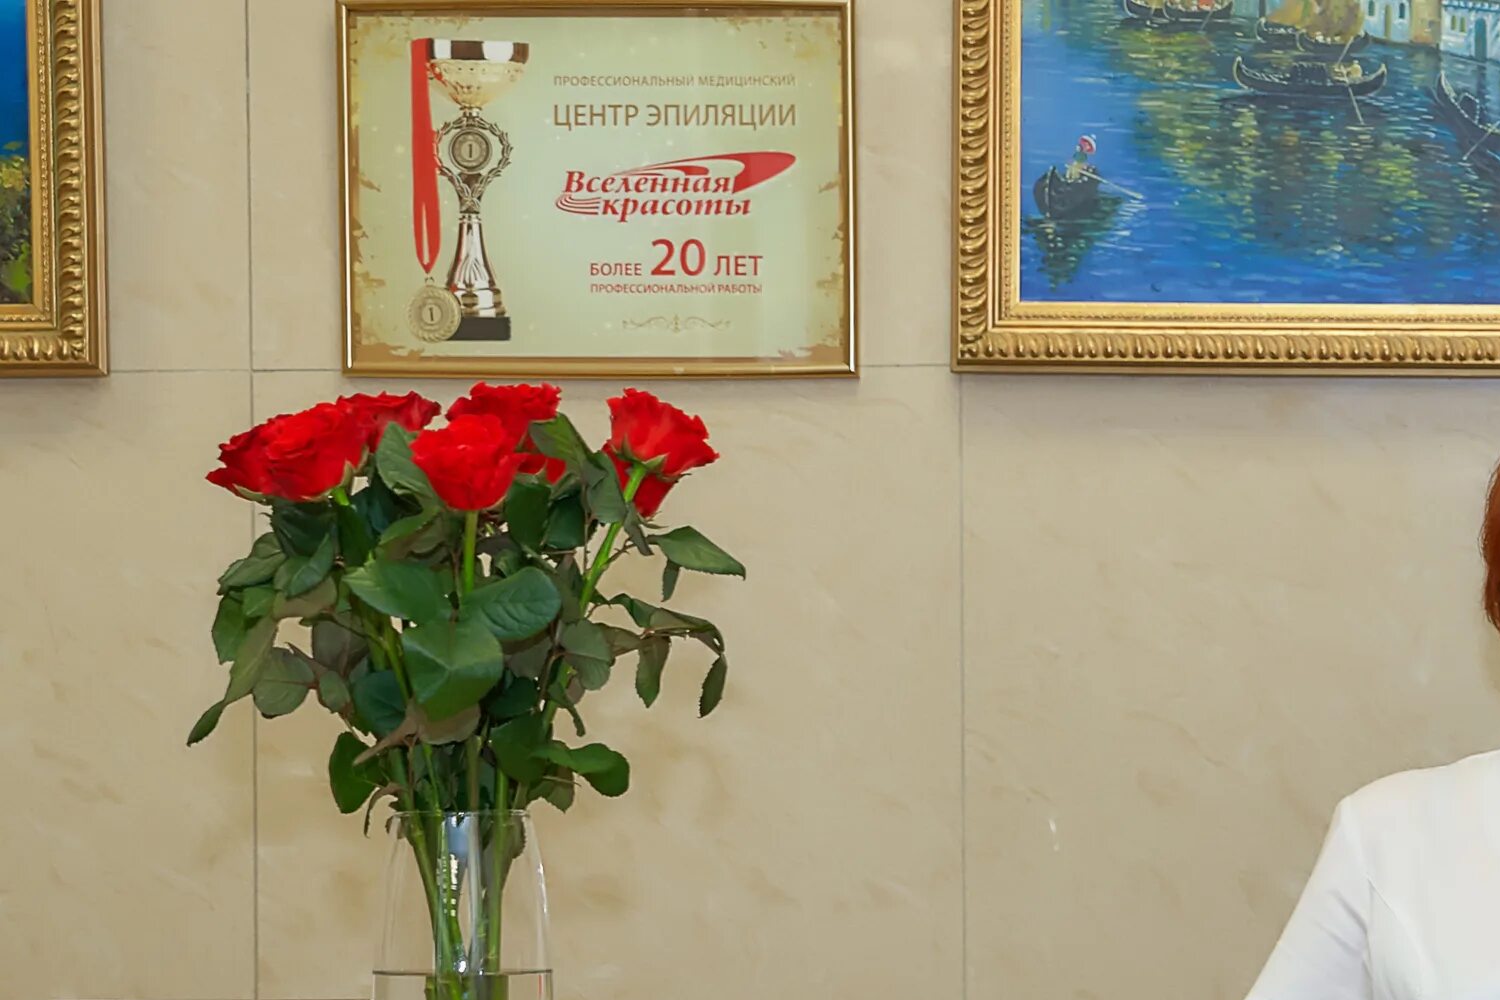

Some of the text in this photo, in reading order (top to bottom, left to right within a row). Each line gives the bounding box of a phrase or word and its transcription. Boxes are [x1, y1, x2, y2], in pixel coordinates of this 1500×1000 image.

[553, 75, 796, 88] ПРОФЕССИОНАЛЬНЫЙ МЕДИЦИНСКИЙ
[553, 103, 797, 131] ЦЕНТР ЭПИЛЯЦИИ
[564, 170, 732, 195] Вселенная
[600, 198, 752, 223] красоты
[590, 238, 764, 277] БОЛЕЕ 20 ЛЕТ
[590, 283, 763, 295] ПРОФЕССИОНАЛЬНОЙ РАБОТЫ
